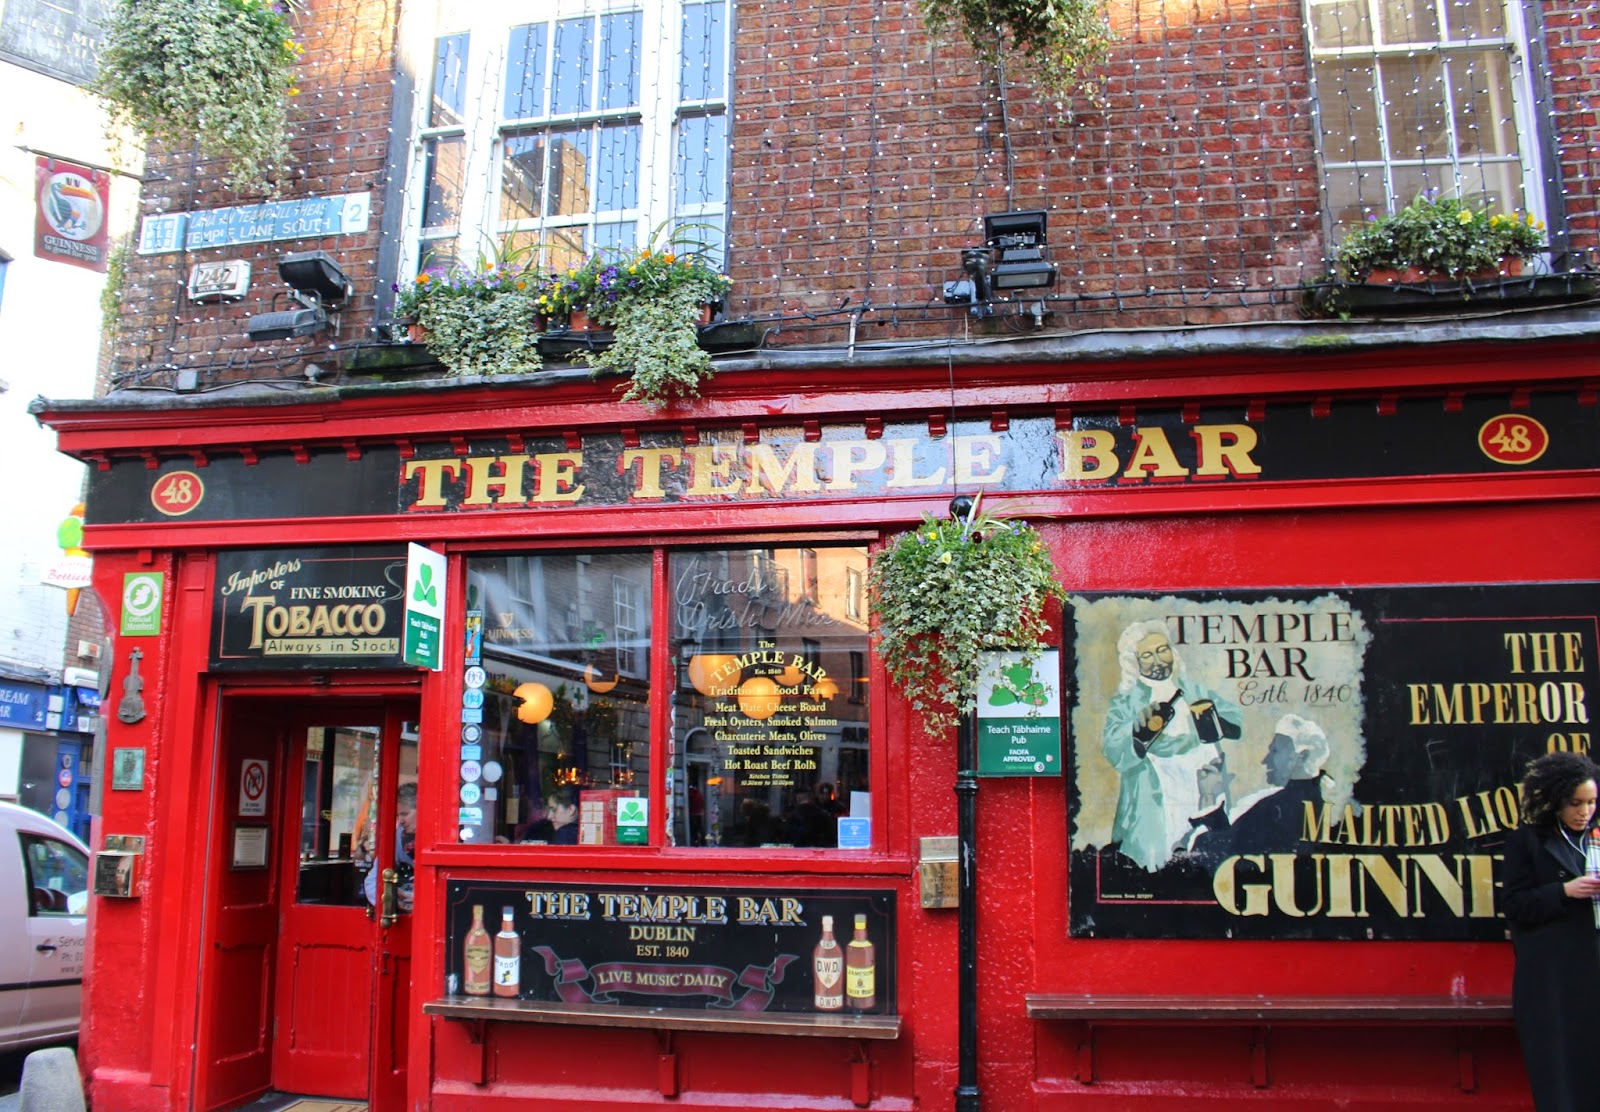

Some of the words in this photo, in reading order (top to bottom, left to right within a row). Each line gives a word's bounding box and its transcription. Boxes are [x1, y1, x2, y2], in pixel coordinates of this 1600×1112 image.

[349, 203, 363, 223] 2
[240, 224, 276, 239] LANE
[282, 217, 331, 234] SOUTH
[44, 234, 97, 255] GUINNESS
[1488, 422, 1532, 454] 48
[403, 451, 586, 512] THE
[619, 433, 1007, 500] TEMPLE
[1056, 423, 1263, 486] BAR
[160, 475, 193, 504] 48
[221, 558, 301, 597] Importers
[270, 580, 285, 590] OF
[290, 586, 323, 600] FINE
[323, 585, 386, 600] SMOKING
[240, 594, 386, 650] TOBACCO
[1165, 612, 1356, 645] TEMPLE
[267, 639, 322, 652] Always
[331, 640, 344, 651] in
[351, 638, 396, 652] Stock
[758, 640, 775, 648] The
[1504, 632, 1585, 673] THE
[711, 651, 785, 683] TEMPLE
[791, 654, 827, 683] BAR
[1225, 647, 1316, 682] BAR
[773, 685, 799, 695] Food
[803, 685, 827, 695] Fare
[1303, 683, 1352, 704] 1840
[715, 702, 737, 712] Meat
[740, 702, 764, 713] Plate,
[767, 702, 797, 712] Cheese
[800, 702, 826, 712] Board
[1407, 681, 1589, 725] EMPEROR
[35, 710, 43, 722] 2
[704, 716, 727, 726] Fresh
[730, 716, 765, 730] Oysters,
[767, 716, 801, 726] Smoked
[804, 716, 838, 726] Salmon
[714, 731, 766, 741] Charcuterie
[769, 731, 797, 742] Meats,
[800, 731, 827, 741] Olives
[987, 725, 1010, 734] Teach
[1012, 725, 1051, 734] Tábhairne
[1011, 735, 1027, 744] Pub
[727, 745, 761, 755] Toasted
[763, 745, 814, 755] Sandwiches
[724, 760, 741, 770] Hot
[744, 760, 768, 770] Roast
[771, 759, 790, 770] Beef
[1300, 801, 1450, 847] MALTED
[1455, 783, 1525, 840] LIQ
[525, 891, 591, 921] THE
[598, 893, 728, 925] TEMPLE
[736, 897, 807, 926] BAR
[629, 925, 696, 942] DUBLIN
[636, 945, 661, 957] EST.
[666, 946, 689, 957] 1840
[599, 971, 632, 985] LIVE
[636, 972, 680, 986] MUSIC
[683, 973, 728, 988] DAILY
